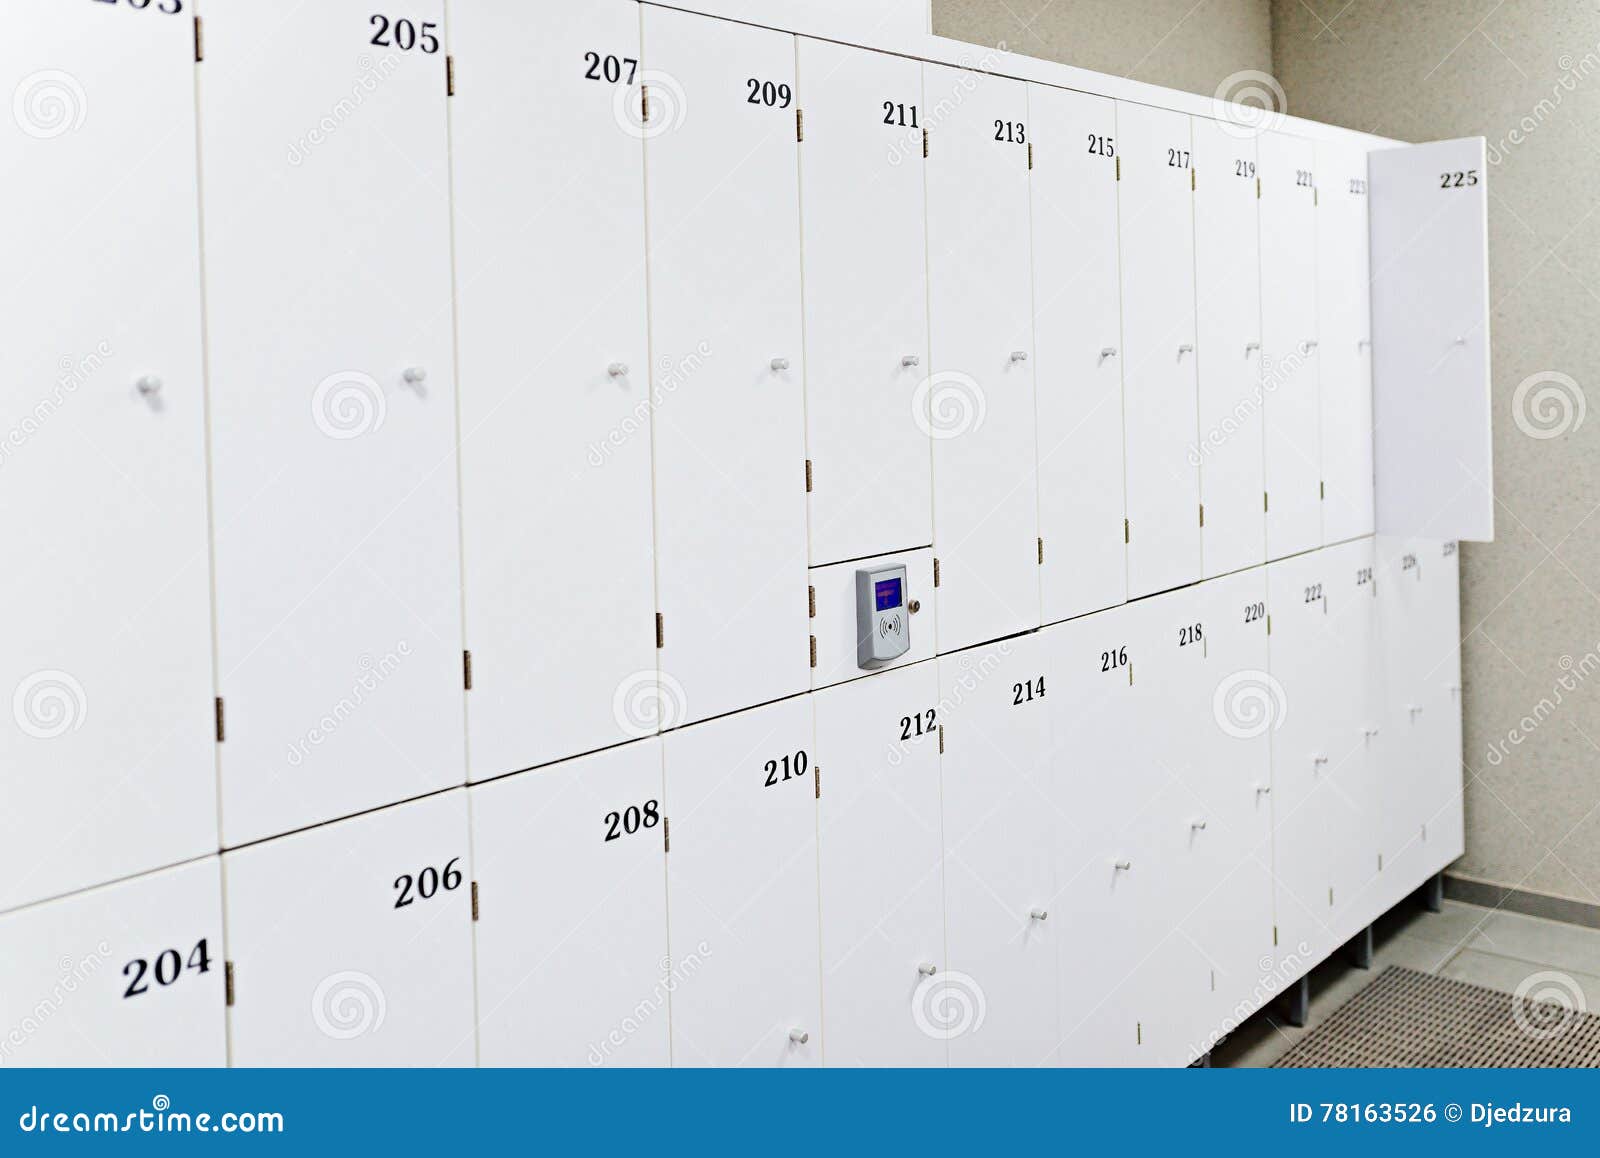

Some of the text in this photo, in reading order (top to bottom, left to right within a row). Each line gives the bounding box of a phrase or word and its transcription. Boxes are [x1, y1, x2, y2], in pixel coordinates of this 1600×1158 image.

[370, 15, 439, 53] 205
[585, 52, 637, 85] 207
[747, 79, 791, 108] 209
[884, 101, 918, 128] 211
[995, 120, 1025, 144] 213
[1088, 134, 1113, 157] 215
[1169, 149, 1189, 168] 217
[1236, 160, 1255, 177] 219
[1441, 171, 1477, 188] 225
[1305, 584, 1321, 603] 222
[1246, 603, 1264, 623] 220
[1180, 623, 1202, 646] 218
[1102, 646, 1127, 672] 216
[1013, 676, 1045, 705] 214
[901, 709, 937, 741] 212
[765, 751, 807, 787] 210
[605, 800, 659, 842] 208
[394, 857, 462, 909] 206
[123, 938, 211, 998] 204
